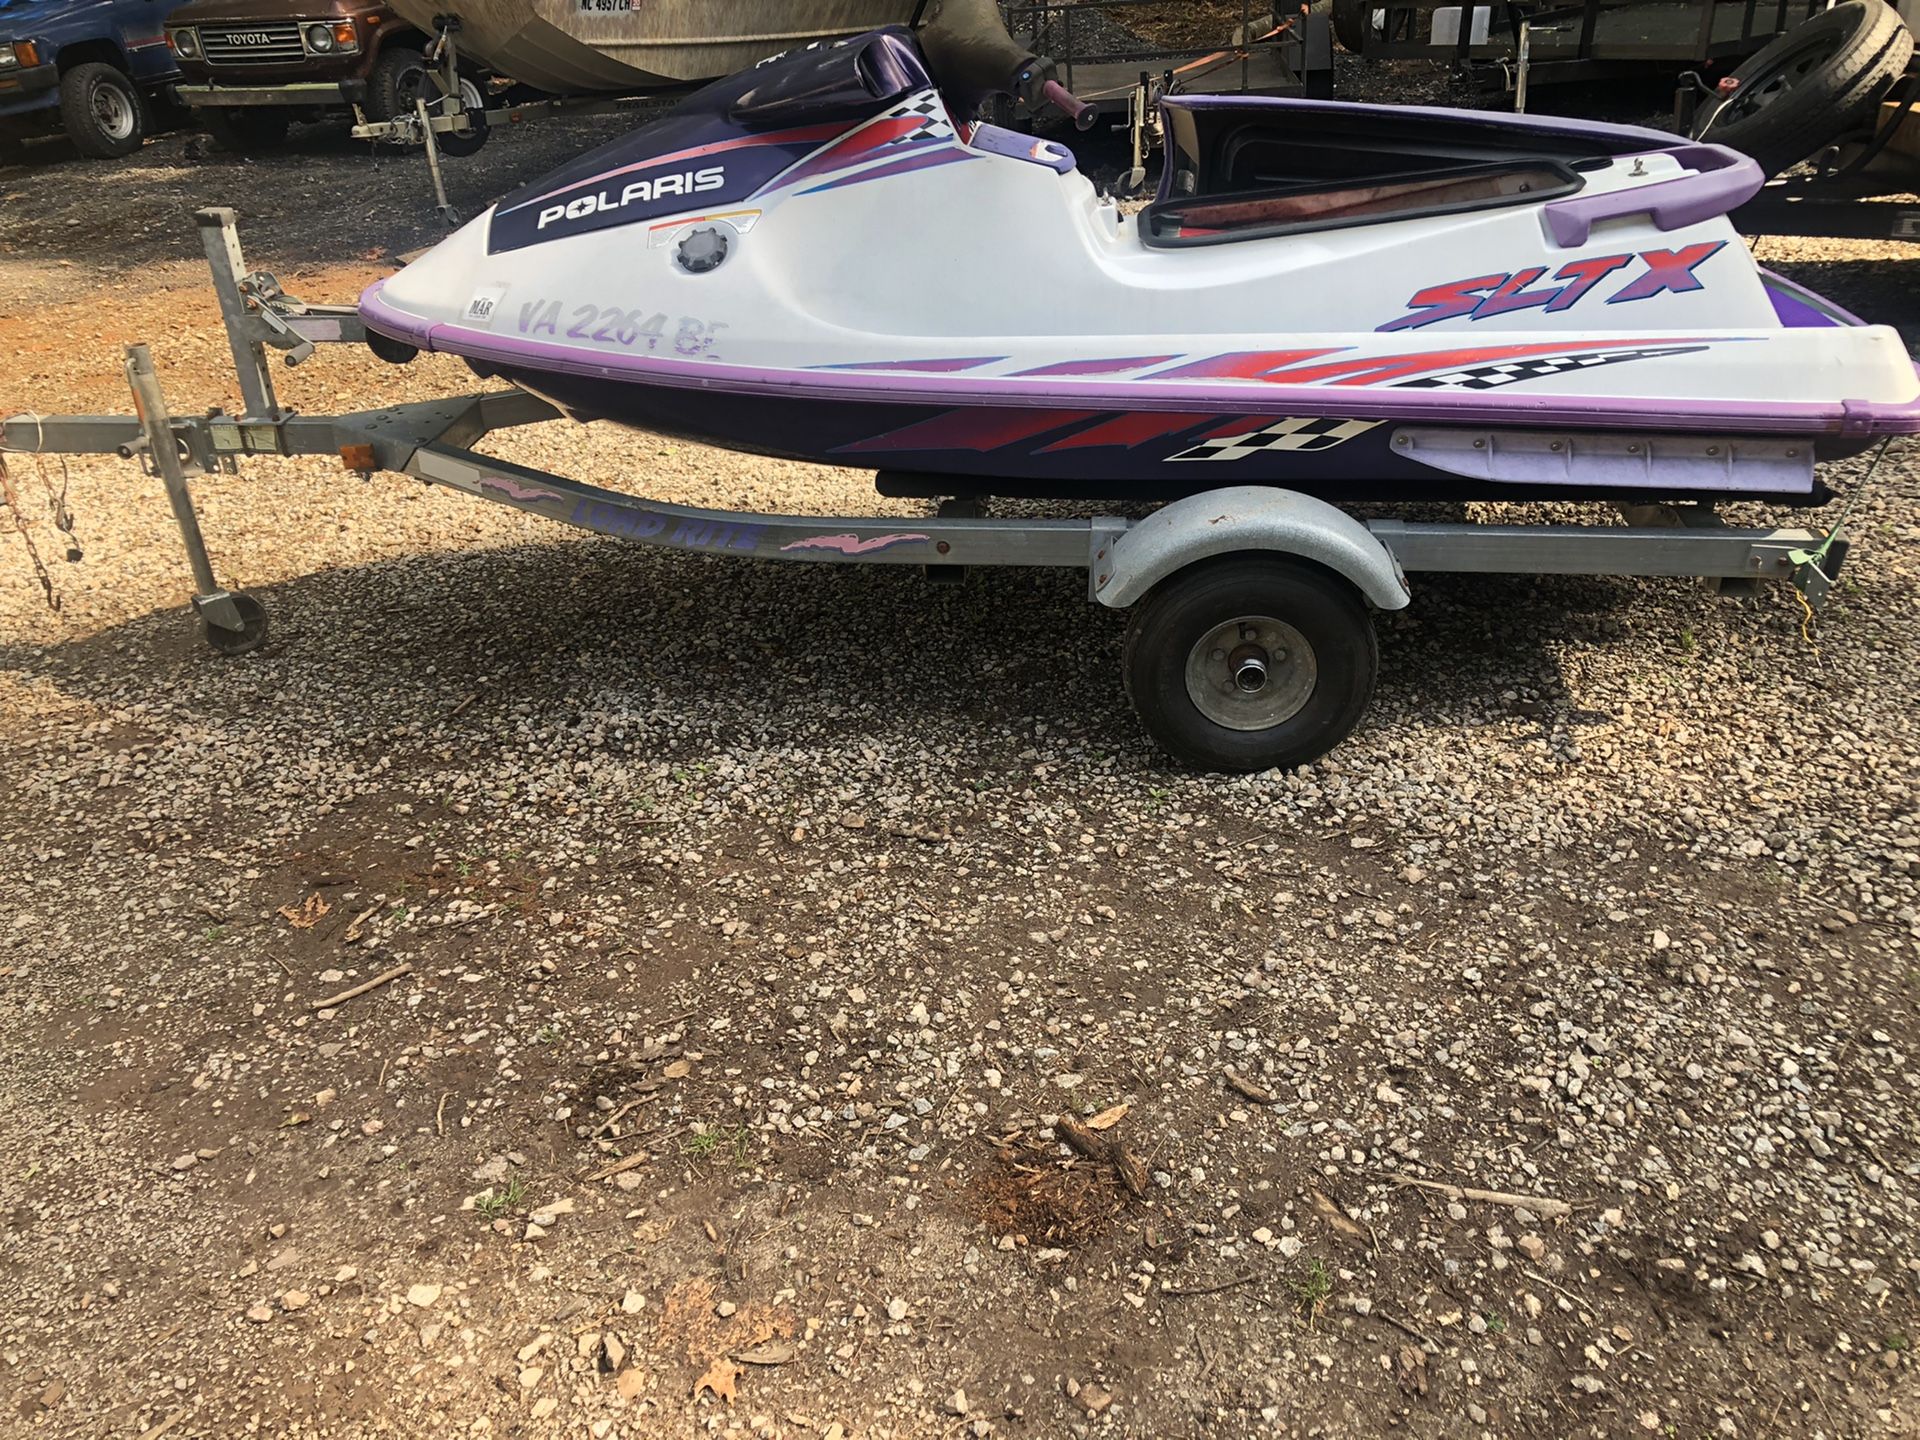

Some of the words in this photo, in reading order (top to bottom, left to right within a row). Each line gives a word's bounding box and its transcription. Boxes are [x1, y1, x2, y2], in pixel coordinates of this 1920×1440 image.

[226, 33, 270, 45] TOYOTA
[537, 166, 725, 230] POLARIS
[469, 300, 493, 315] MAR
[518, 299, 563, 335] VA
[566, 304, 668, 349] 2264
[570, 501, 666, 537] LOAD
[670, 518, 769, 550] RITE
